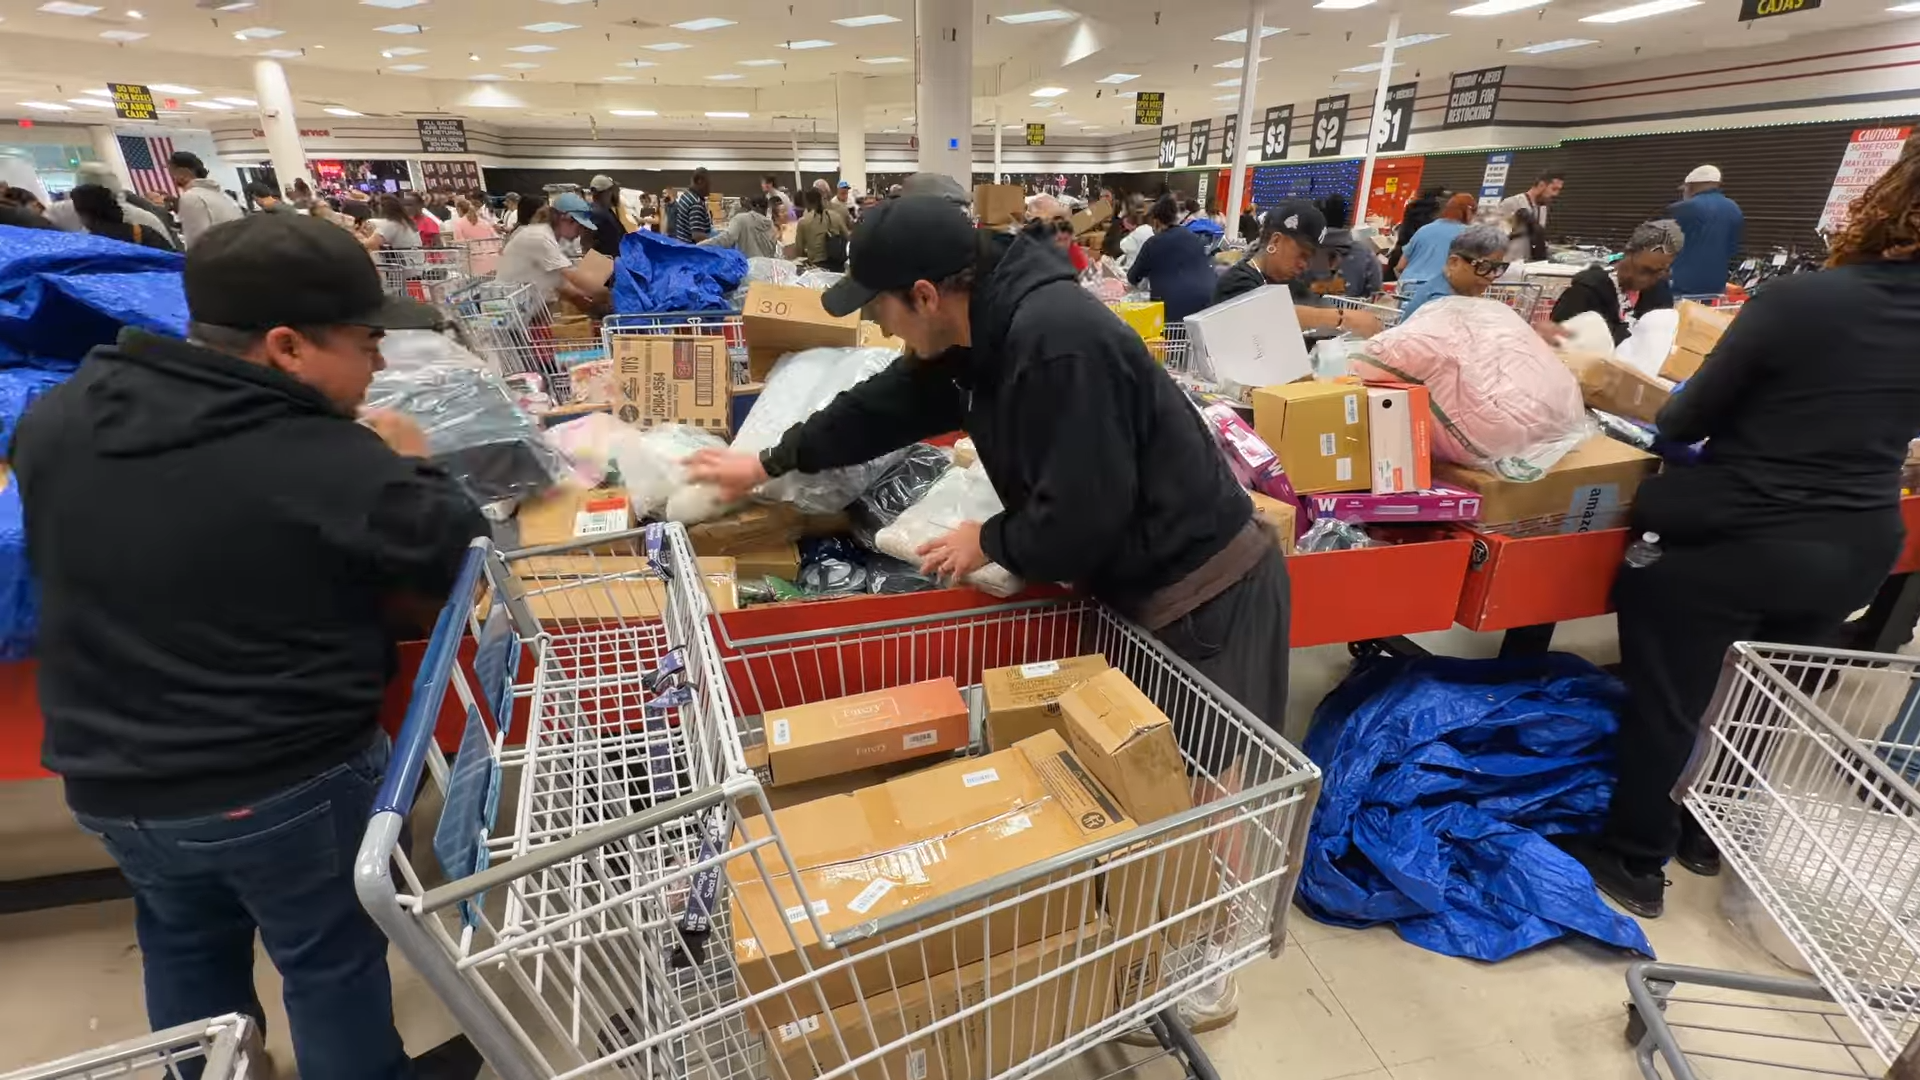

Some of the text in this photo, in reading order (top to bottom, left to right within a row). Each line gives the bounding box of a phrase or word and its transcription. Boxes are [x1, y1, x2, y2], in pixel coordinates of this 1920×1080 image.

[115, 102, 129, 110] NO
[1450, 88, 1497, 108] CLOSED FOR
[125, 110, 150, 119] CAJAS
[1446, 104, 1493, 124] RESTOCKING
[299, 129, 331, 137] ervice
[1315, 114, 1340, 154] $2
[1376, 104, 1403, 149] $1
[1857, 128, 1901, 142] CAUTION
[1190, 133, 1206, 164] $7
[1265, 122, 1286, 158] $3
[1849, 142, 1900, 152] SOME FOOD
[1159, 137, 1176, 167] $10
[1858, 151, 1884, 159] ITEMS
[1844, 159, 1861, 167] MAY
[759, 300, 788, 316] 30
[621, 356, 640, 374] TOYS
[1267, 458, 1285, 477] W
[1317, 498, 1338, 512] W
[1577, 487, 1602, 533] amazo
[704, 879, 717, 899] Seat
